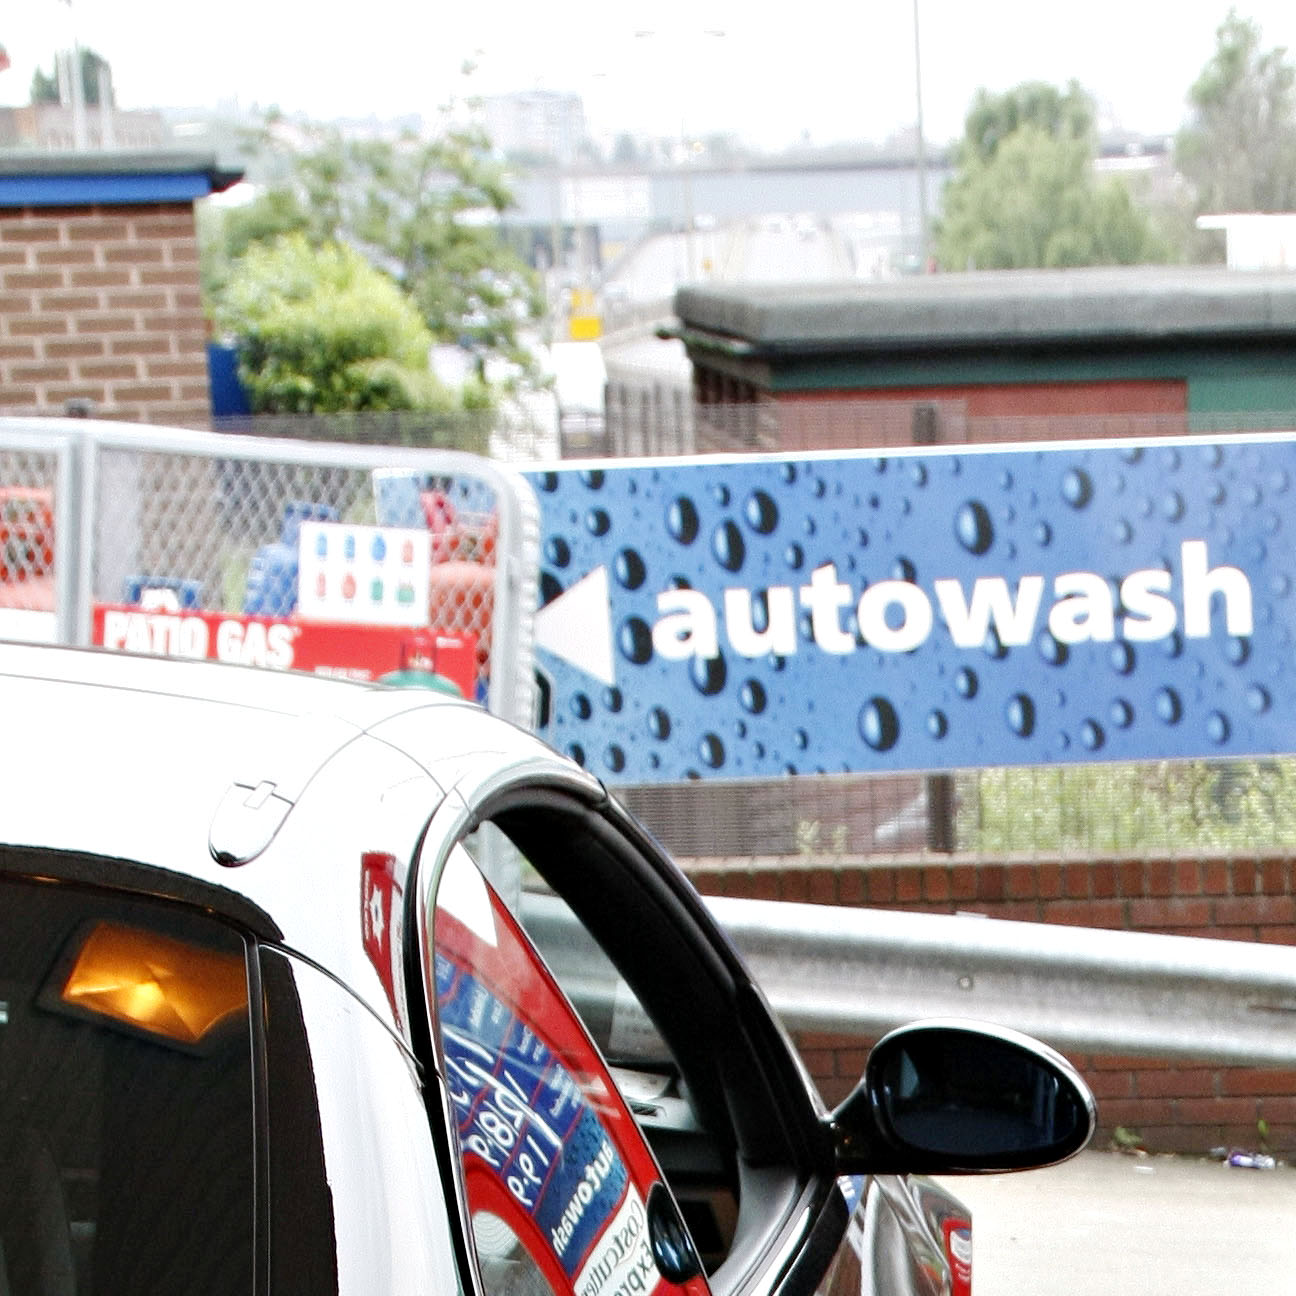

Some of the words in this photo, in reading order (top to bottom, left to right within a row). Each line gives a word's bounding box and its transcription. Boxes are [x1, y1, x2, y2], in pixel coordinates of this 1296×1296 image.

[104, 611, 209, 660] PATIO
[217, 619, 295, 668] GAS
[651, 540, 1253, 661] autowash
